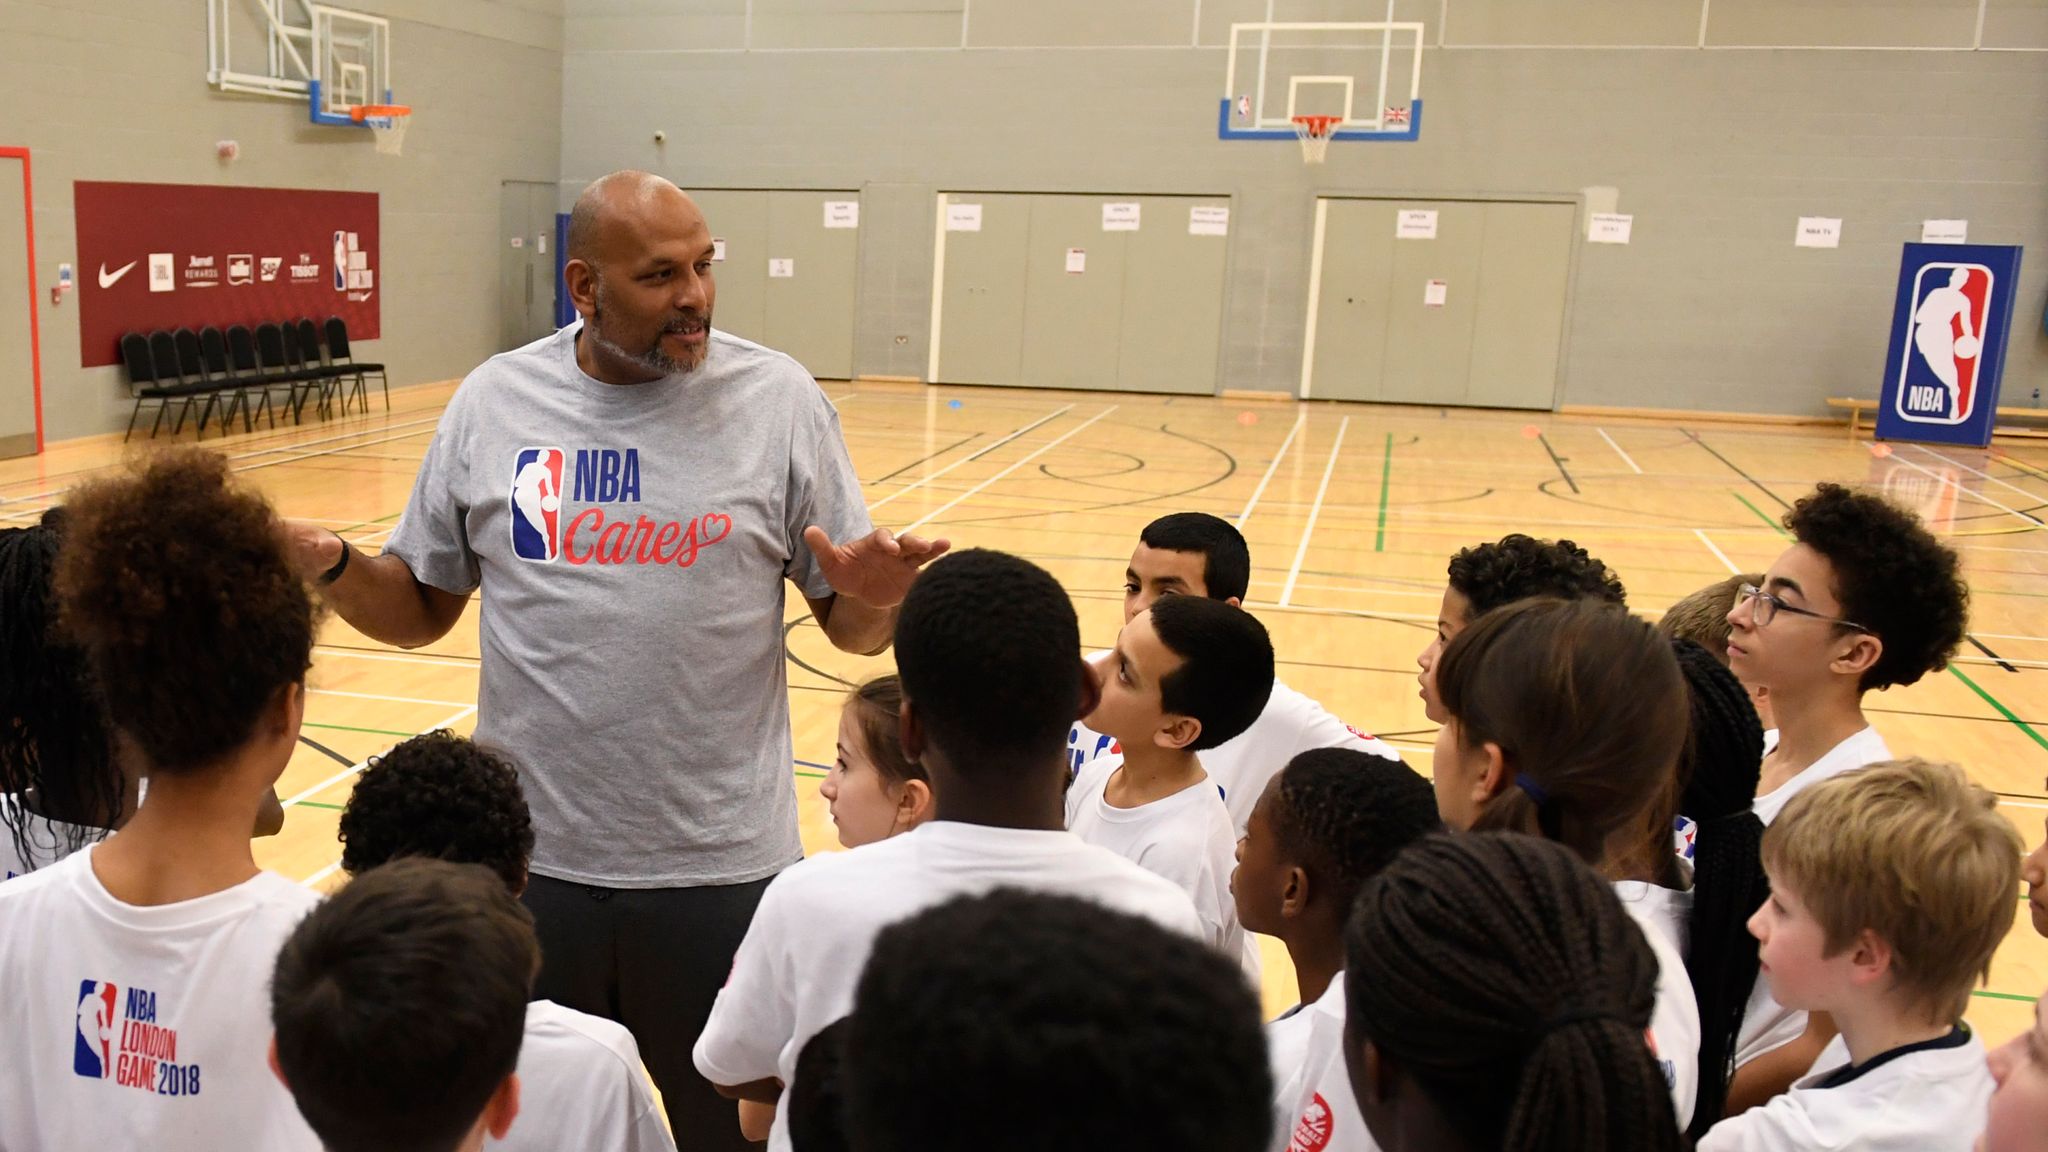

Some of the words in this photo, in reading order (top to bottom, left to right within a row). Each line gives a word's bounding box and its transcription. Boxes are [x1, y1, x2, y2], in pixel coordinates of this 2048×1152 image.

[1908, 385, 1944, 412] NBA
[573, 448, 641, 502] NBA
[563, 507, 700, 568] Cares
[125, 986, 156, 1023] NBA
[120, 1019, 177, 1063] LONDON
[116, 1053, 157, 1092] GAME
[158, 1062, 200, 1096] 2018
